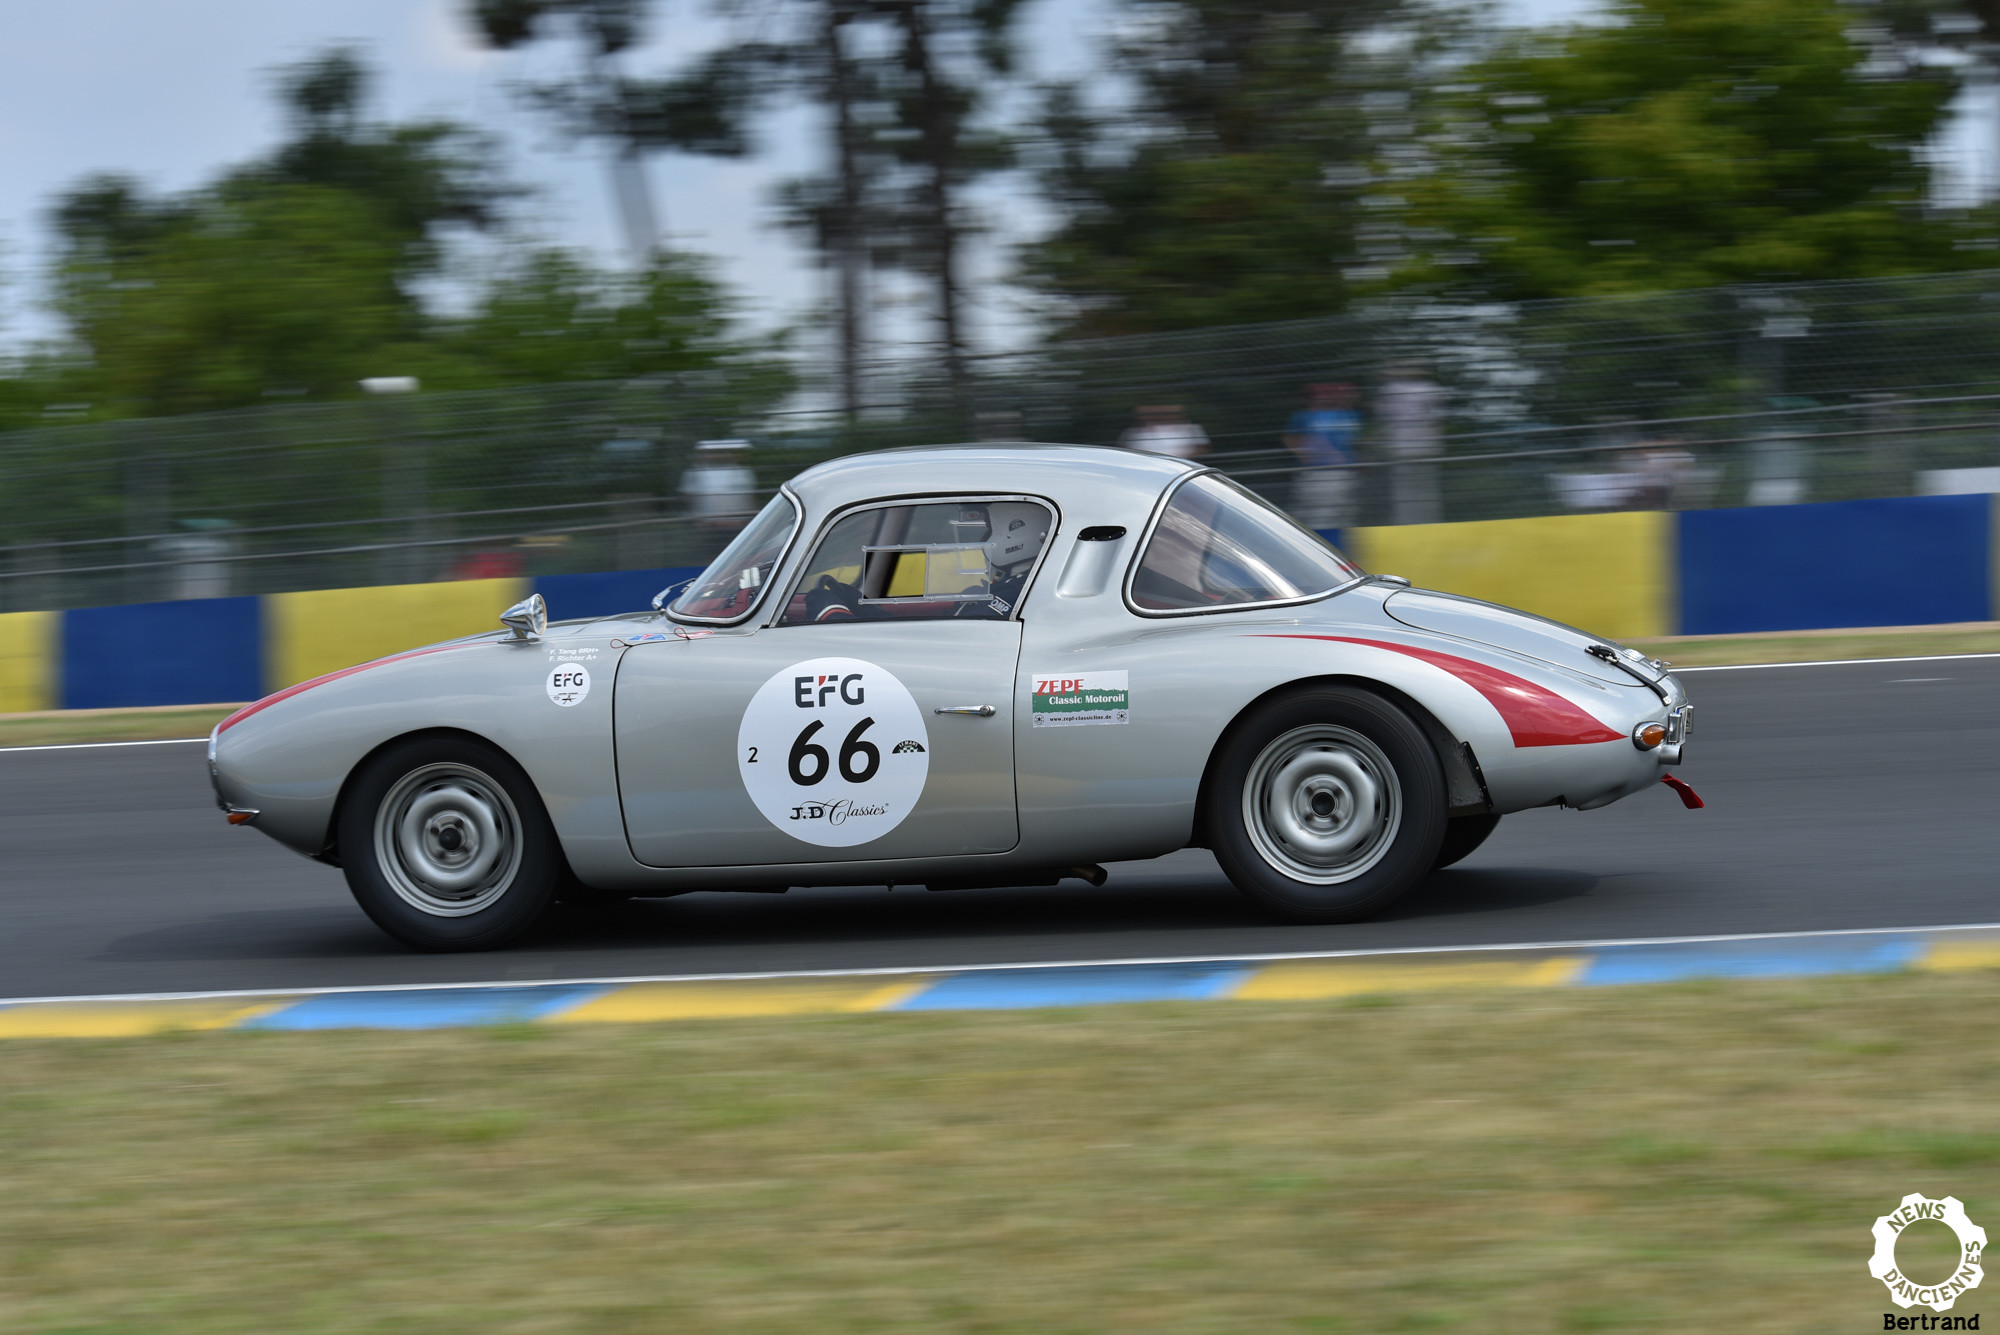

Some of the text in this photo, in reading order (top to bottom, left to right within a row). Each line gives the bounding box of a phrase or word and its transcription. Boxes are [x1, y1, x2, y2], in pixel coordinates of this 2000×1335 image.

[553, 673, 583, 687] EFG
[1036, 679, 1084, 696] ZEPF
[795, 674, 864, 708] EFG
[1049, 694, 1125, 705] Classic Motoroil
[747, 747, 758, 763] 2
[788, 716, 880, 786] 66
